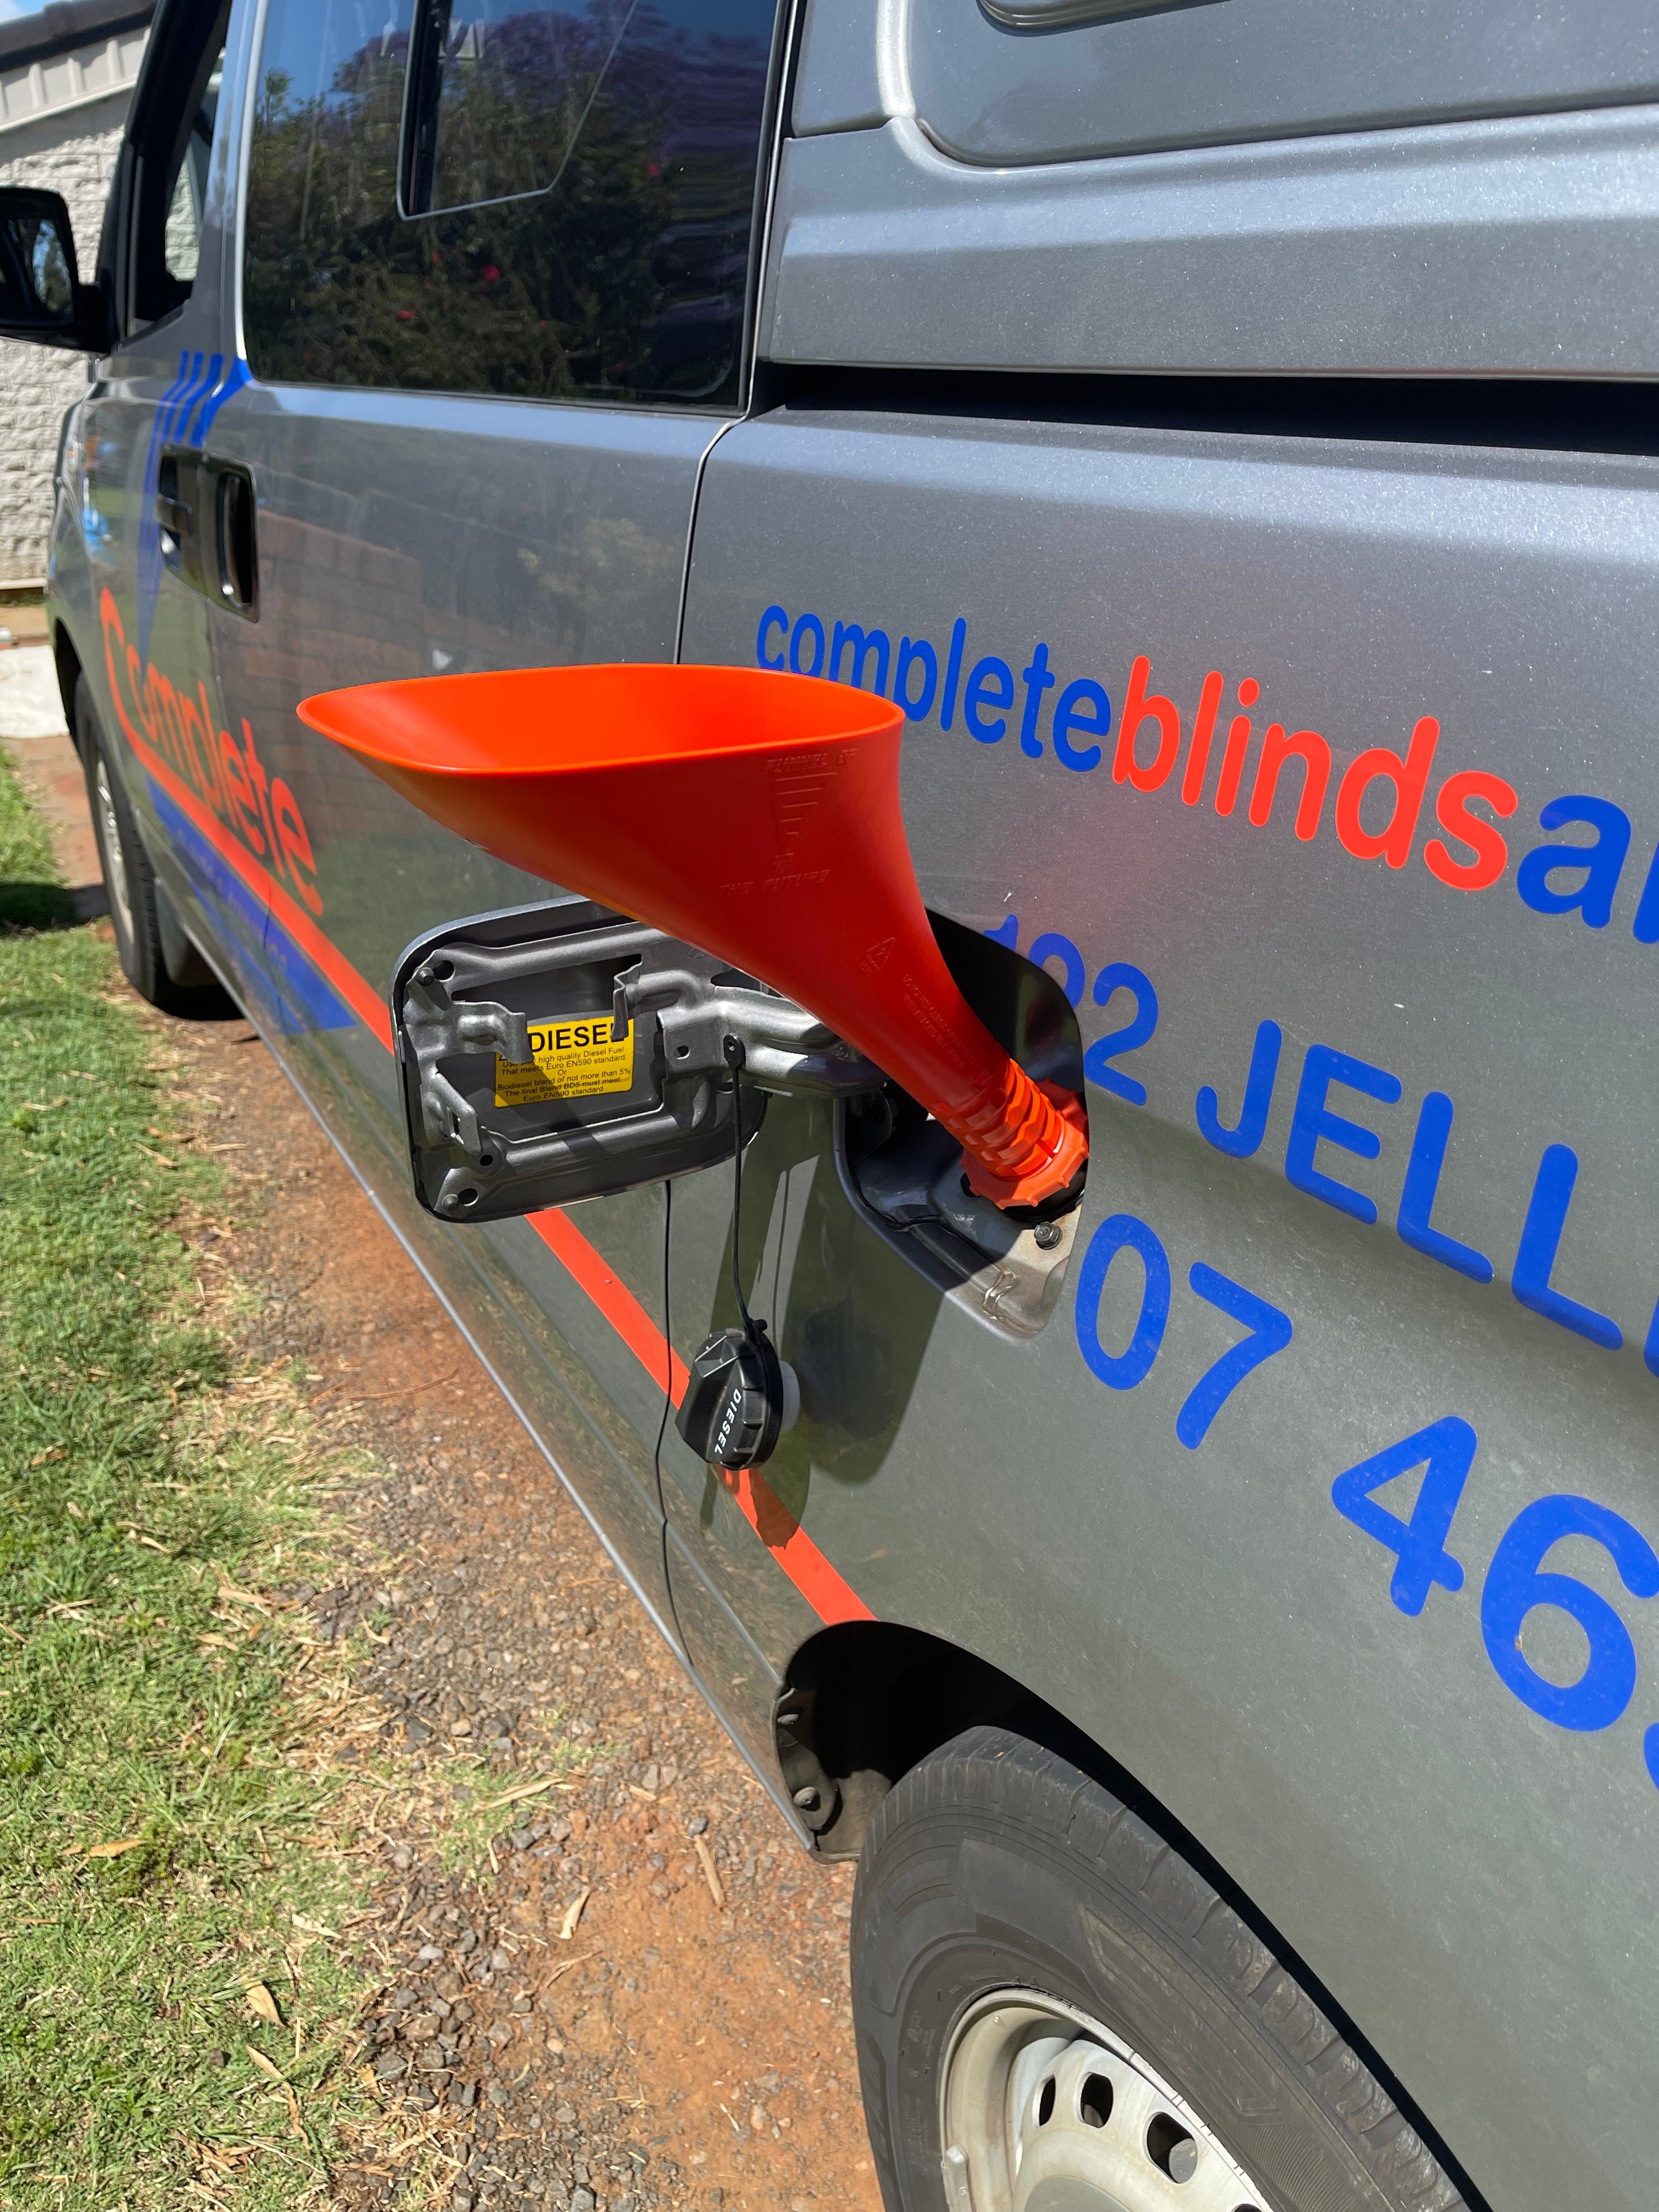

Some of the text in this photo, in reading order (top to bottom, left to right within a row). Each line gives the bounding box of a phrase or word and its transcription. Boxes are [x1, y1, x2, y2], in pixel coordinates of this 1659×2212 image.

[99, 587, 323, 916] Complete
[501, 1055, 625, 1075] That meets Euro EN590 standard
[538, 1055, 555, 1063] high
[557, 1053, 581, 1062] quality
[584, 1048, 606, 1057] Diesel
[498, 1080, 532, 1091] Biodiesel
[534, 1077, 555, 1086] blend
[567, 1074, 579, 1082] not
[522, 1087, 538, 1095] final
[540, 1084, 561, 1093] Blend
[564, 1081, 580, 1089] BD5
[544, 1090, 569, 1099] EN590
[572, 1086, 603, 1095] standard
[1196, 1020, 1659, 1378] JELL
[714, 1388, 742, 1454] DIESEL
[1075, 1214, 1659, 1794] 07 46
